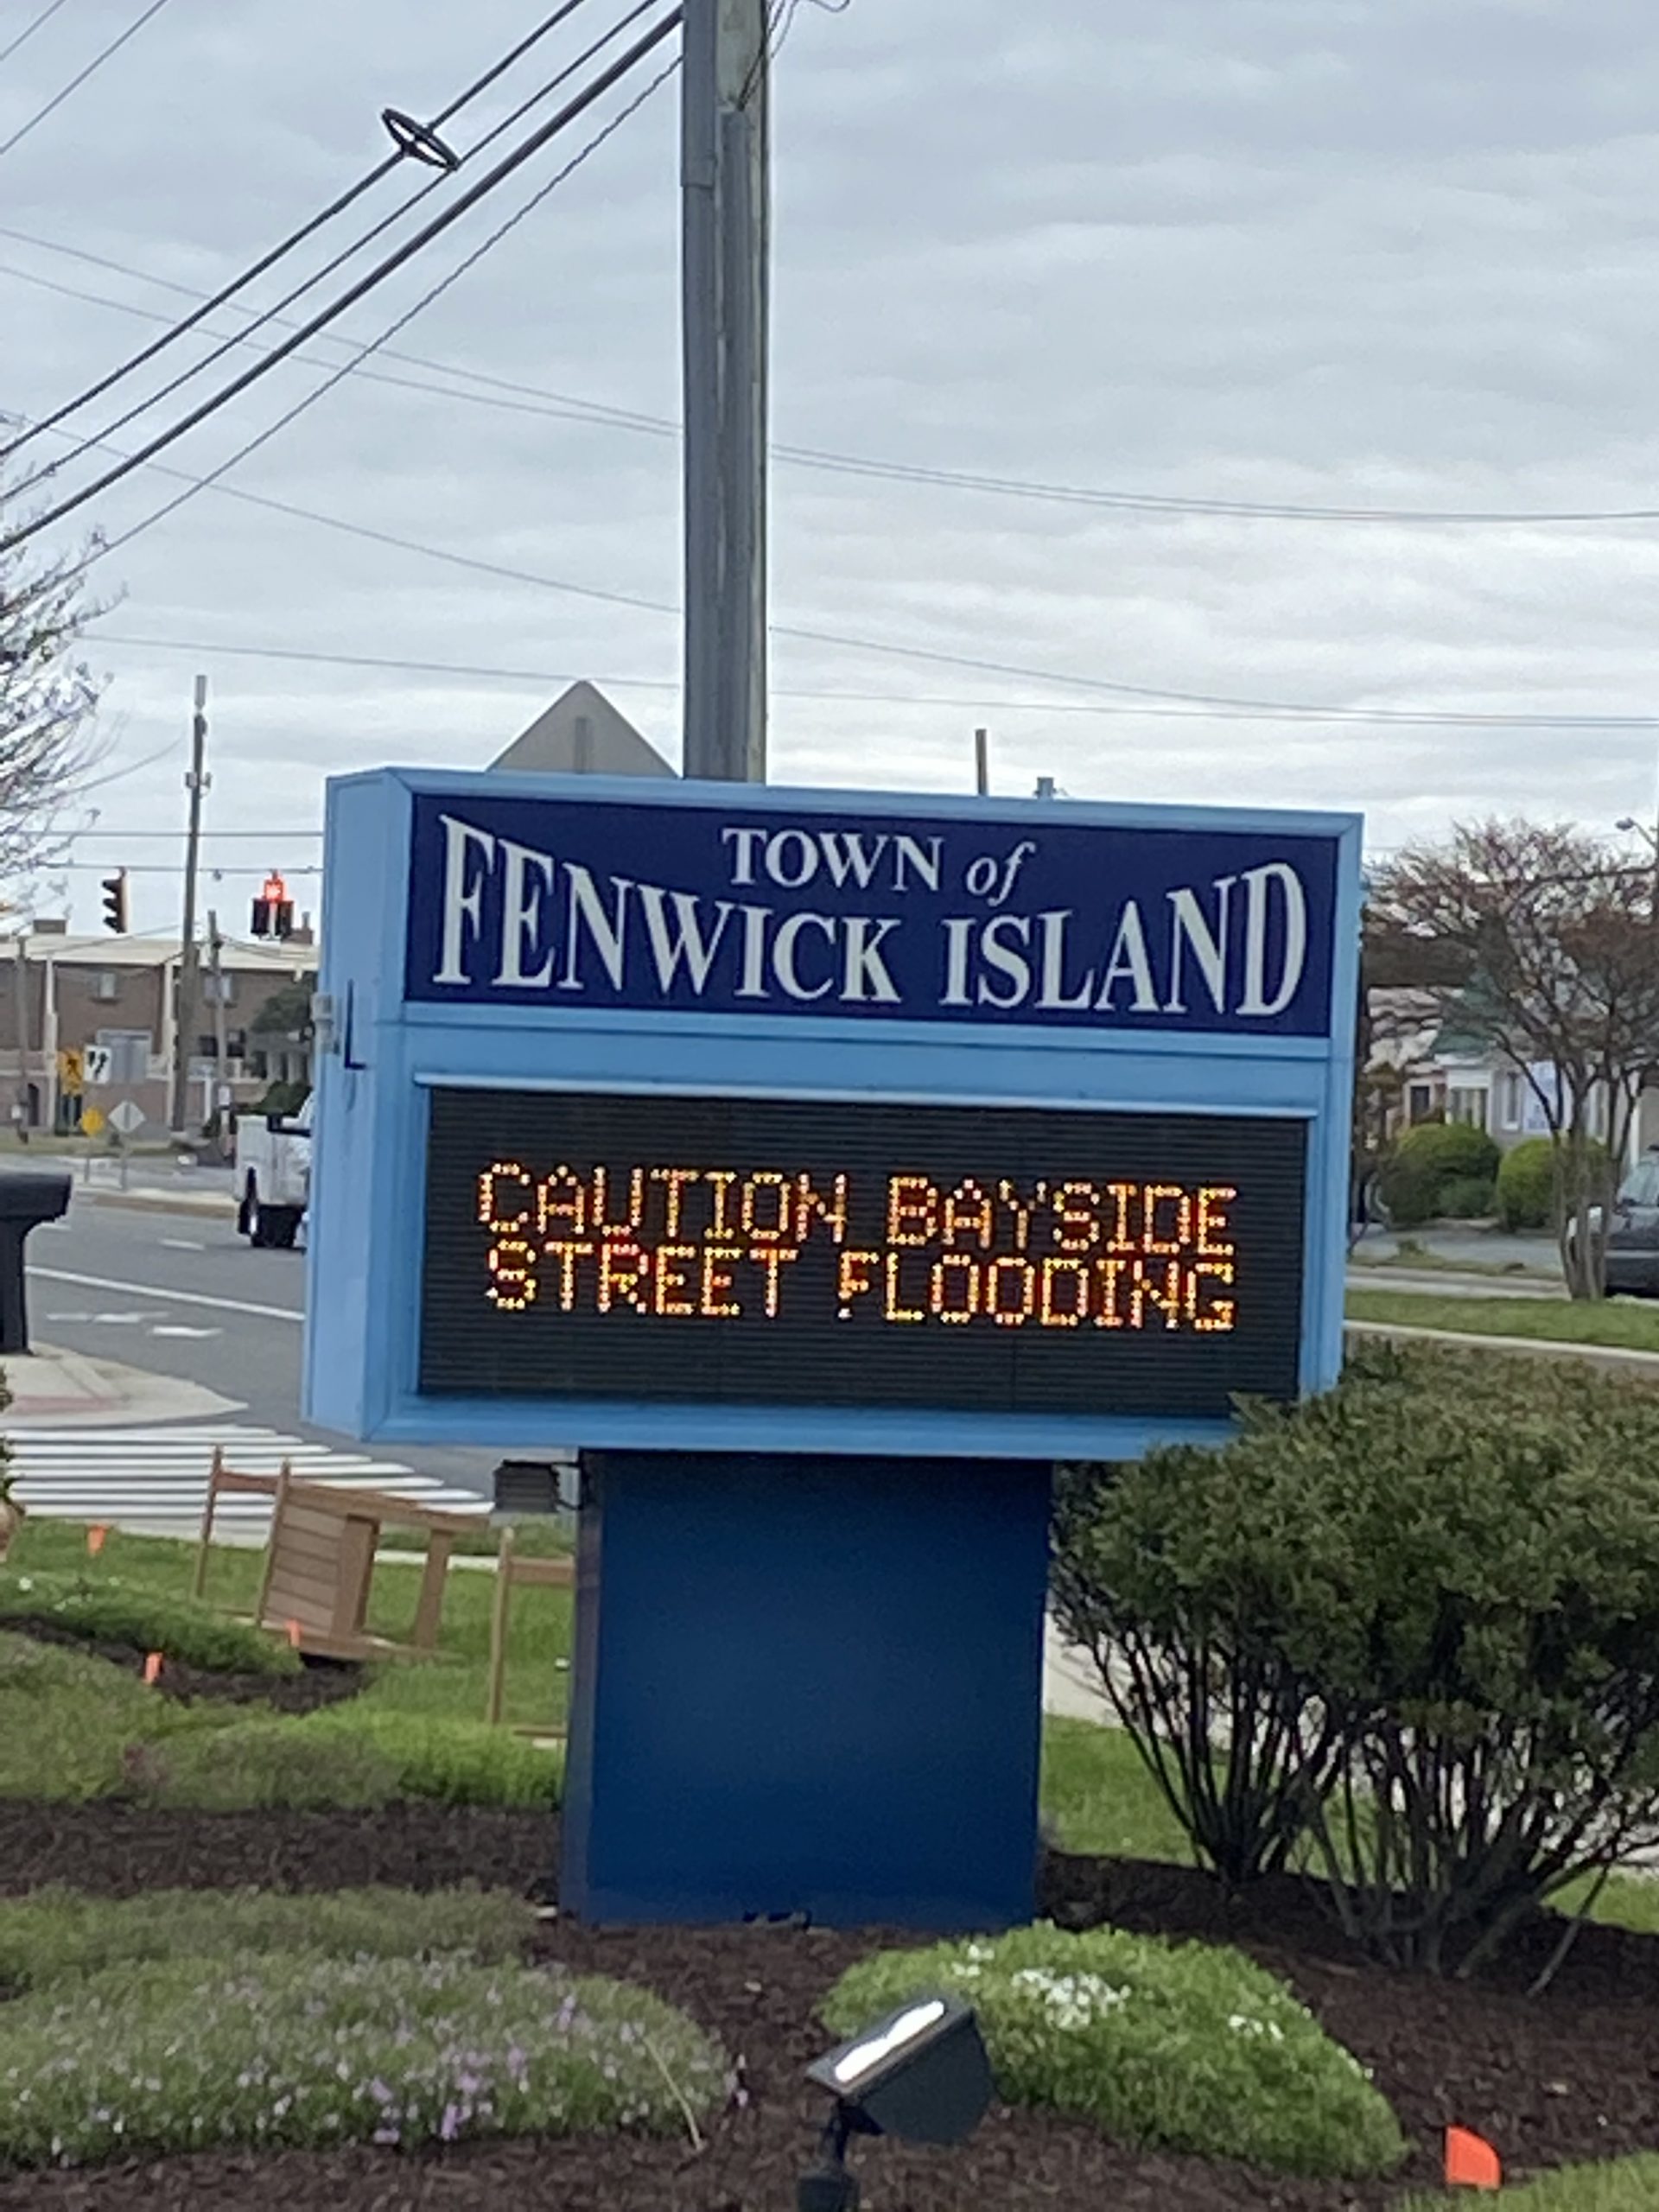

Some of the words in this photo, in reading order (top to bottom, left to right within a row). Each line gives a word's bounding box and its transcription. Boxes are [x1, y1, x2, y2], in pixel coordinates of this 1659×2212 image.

[722, 828, 942, 890] TOWN
[967, 841, 1036, 906] of
[432, 814, 901, 1002] FENWICK
[939, 861, 1305, 1016] ISLAND
[478, 1163, 846, 1243] CAUTION
[887, 1176, 1237, 1255] BAYSIDE
[485, 1240, 798, 1318] STREET
[837, 1250, 1235, 1332] FLOODING
